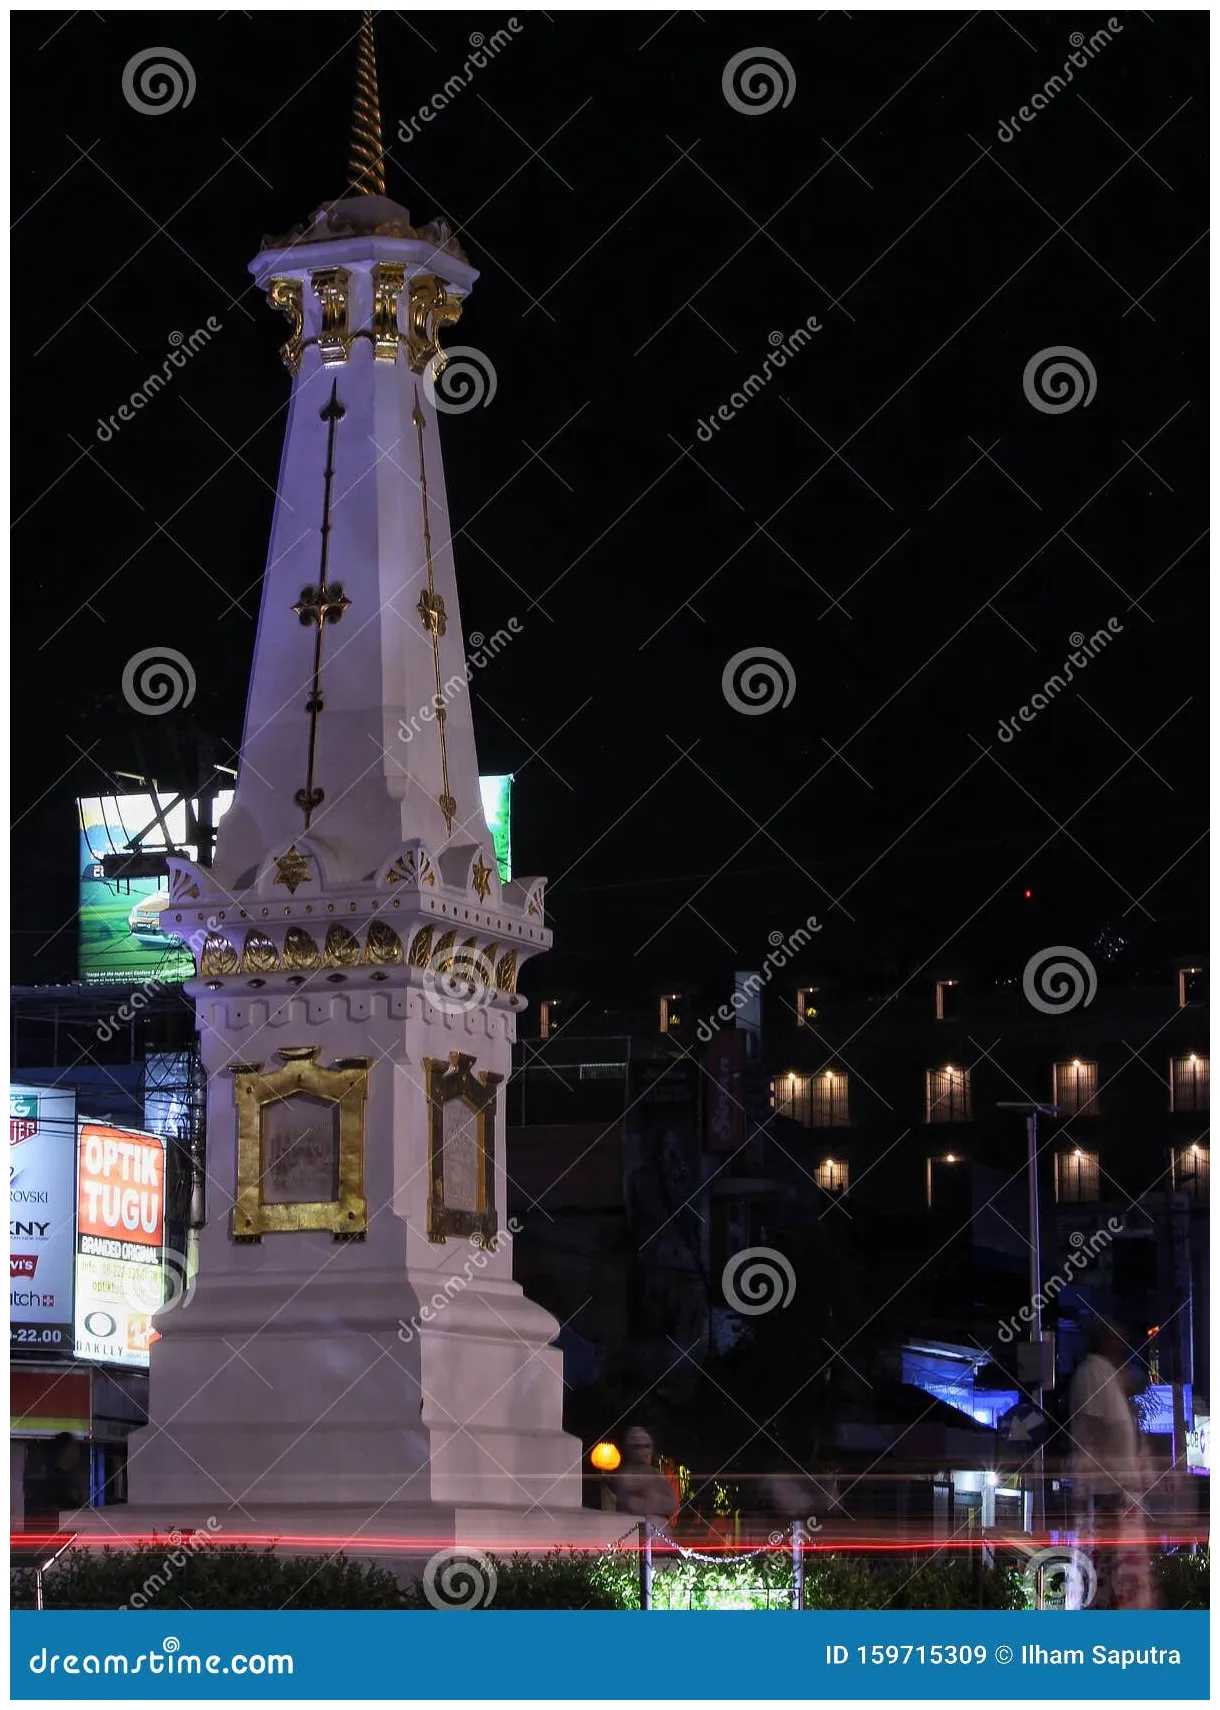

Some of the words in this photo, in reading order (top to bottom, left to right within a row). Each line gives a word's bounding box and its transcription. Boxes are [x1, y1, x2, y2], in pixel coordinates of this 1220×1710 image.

[85, 1135, 159, 1187] OPTIK
[84, 1180, 159, 1234] TUGU
[81, 1235, 121, 1259] BRANDED
